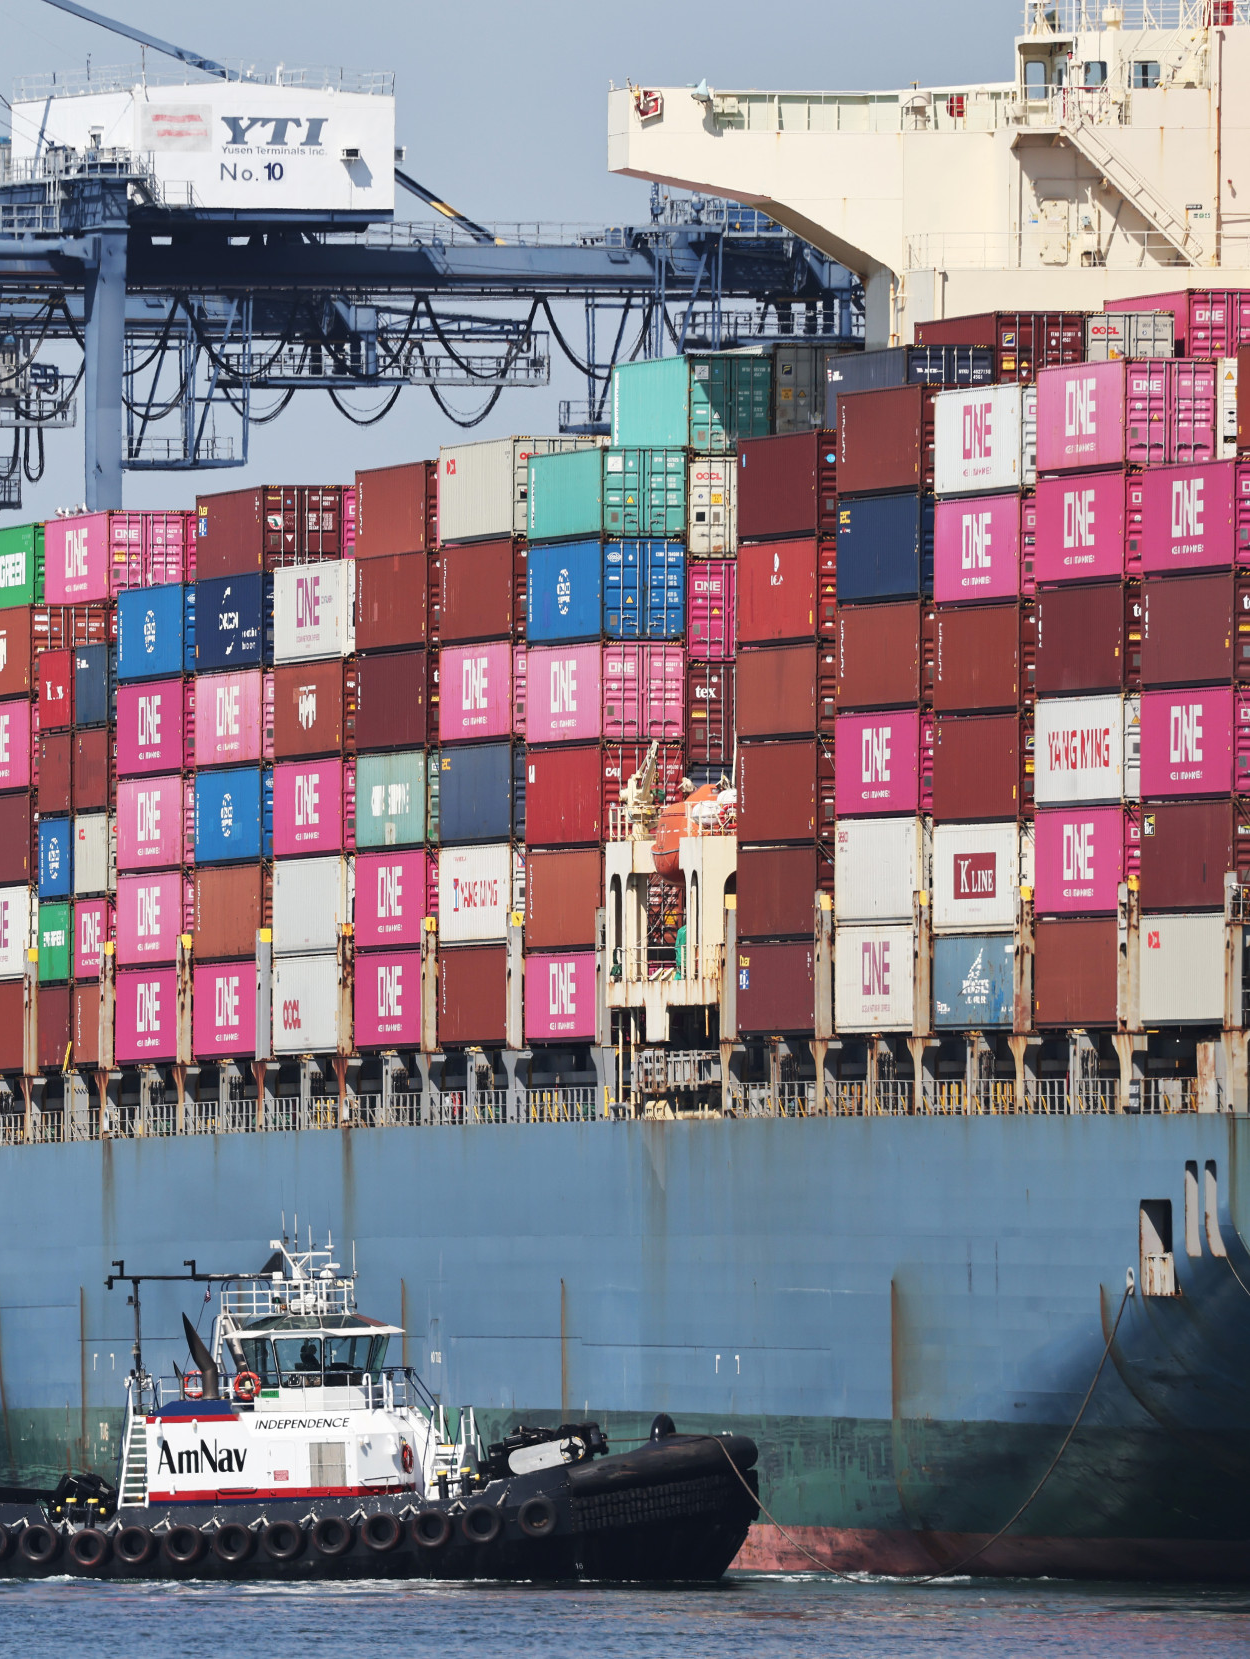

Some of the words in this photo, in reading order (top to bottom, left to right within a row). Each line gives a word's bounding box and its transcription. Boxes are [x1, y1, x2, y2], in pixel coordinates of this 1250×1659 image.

[221, 116, 329, 146] YTI
[222, 146, 253, 155] Yusen
[256, 146, 306, 156] Terminals
[309, 147, 328, 156] Inc.
[1196, 310, 1224, 321] ONE
[1065, 378, 1096, 437] ONE
[1133, 380, 1161, 391] ONE
[963, 403, 991, 459] ONE
[1064, 490, 1094, 548] ONE
[1172, 478, 1203, 537] ONE
[65, 528, 88, 578] ONE
[115, 529, 138, 539] ONE
[962, 512, 991, 569] ONE
[297, 576, 320, 628] ONE
[695, 581, 721, 591] ONE
[462, 657, 488, 710] ONE
[550, 661, 576, 713] ONE
[608, 661, 635, 673] ONE
[695, 685, 717, 698] tex
[139, 695, 161, 745] ONE
[216, 685, 240, 736] ONE
[1170, 705, 1202, 762] ONE
[862, 727, 891, 782] ONE
[1048, 730, 1077, 771] YANG
[1081, 728, 1110, 769] MING
[137, 790, 160, 841] ONE
[295, 774, 319, 825] ONE
[1063, 823, 1093, 880] ONE
[378, 866, 402, 917] ONE
[971, 869, 994, 892] LINE
[82, 912, 101, 953] ONE
[137, 886, 160, 936] ONE
[378, 966, 402, 1016] ONE
[550, 963, 575, 1014] ONE
[863, 942, 889, 995] ONE
[137, 982, 160, 1032] ONE
[216, 977, 239, 1026] ONE
[254, 1417, 349, 1430] INDEPENDENCE
[158, 1439, 247, 1475] AmNav
